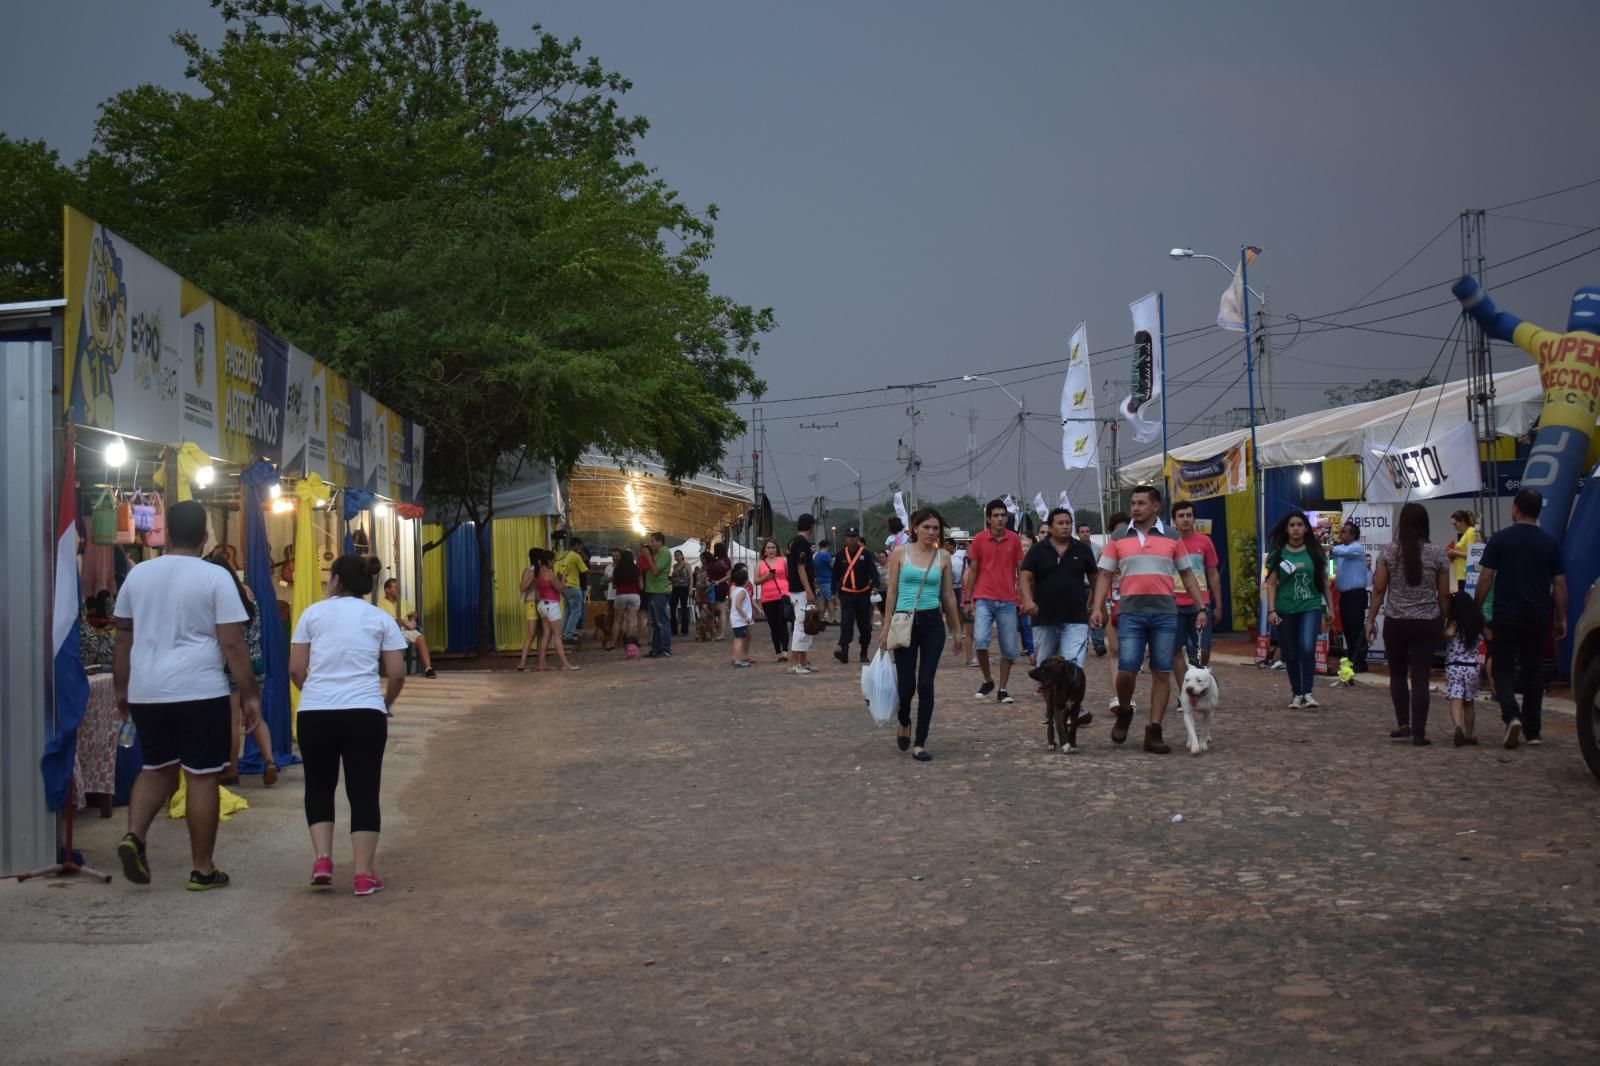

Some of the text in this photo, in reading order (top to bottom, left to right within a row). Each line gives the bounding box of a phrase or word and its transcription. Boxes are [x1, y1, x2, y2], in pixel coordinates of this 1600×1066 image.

[131, 312, 160, 363] EXPO
[225, 341, 264, 388] PASEO LOS
[1542, 368, 1600, 399] RECIOS
[225, 384, 280, 446] ARTESANOS
